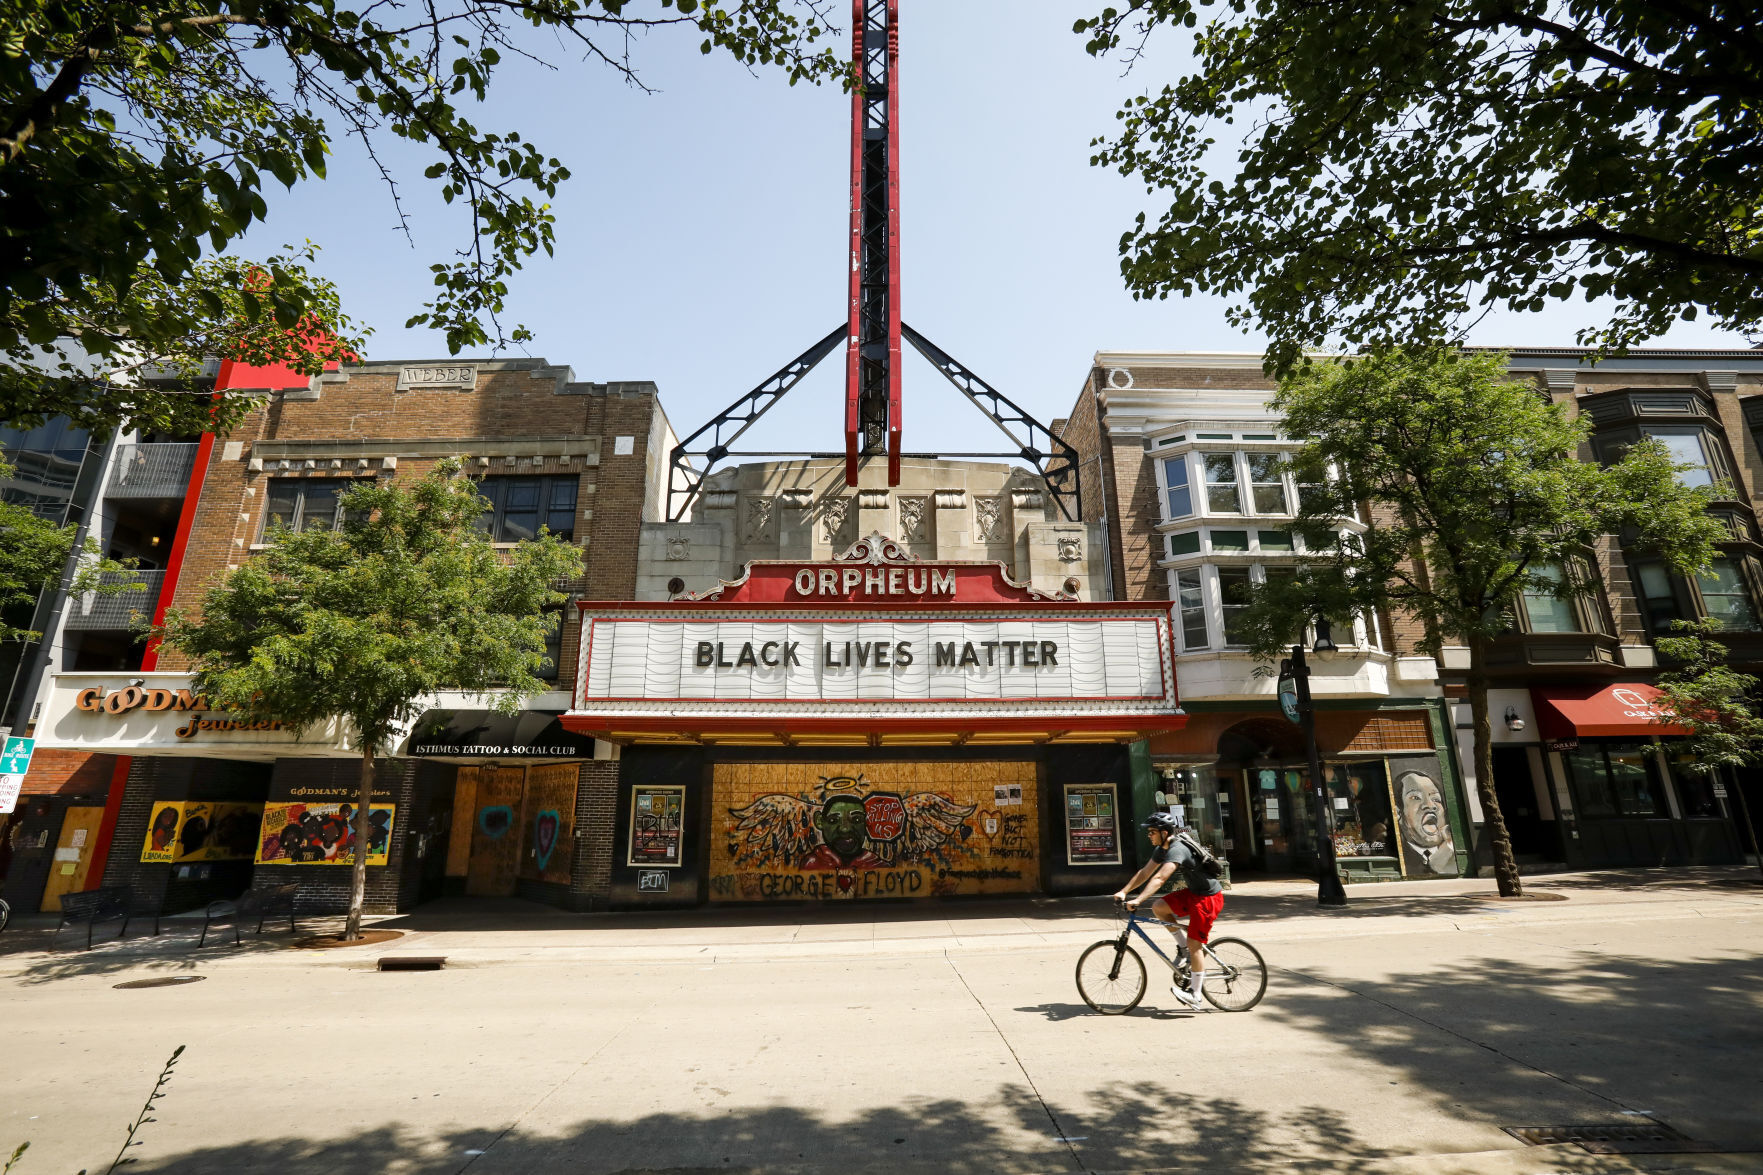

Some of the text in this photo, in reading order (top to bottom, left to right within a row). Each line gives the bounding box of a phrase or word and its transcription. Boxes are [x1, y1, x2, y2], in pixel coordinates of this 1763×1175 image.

[405, 368, 472, 382] WEBER
[795, 568, 957, 596] ORPHEUM
[695, 641, 1059, 667] BLACK LIVES MATTER
[415, 744, 576, 755] ISTHMUS TATTOO & SOCIAL CLUB
[870, 802, 899, 812] STOP
[865, 811, 904, 824] KILLING
[874, 823, 894, 838] US
[1001, 835, 1028, 850] NOT
[759, 872, 834, 899] GEORGE
[864, 870, 922, 895] FLOYD
